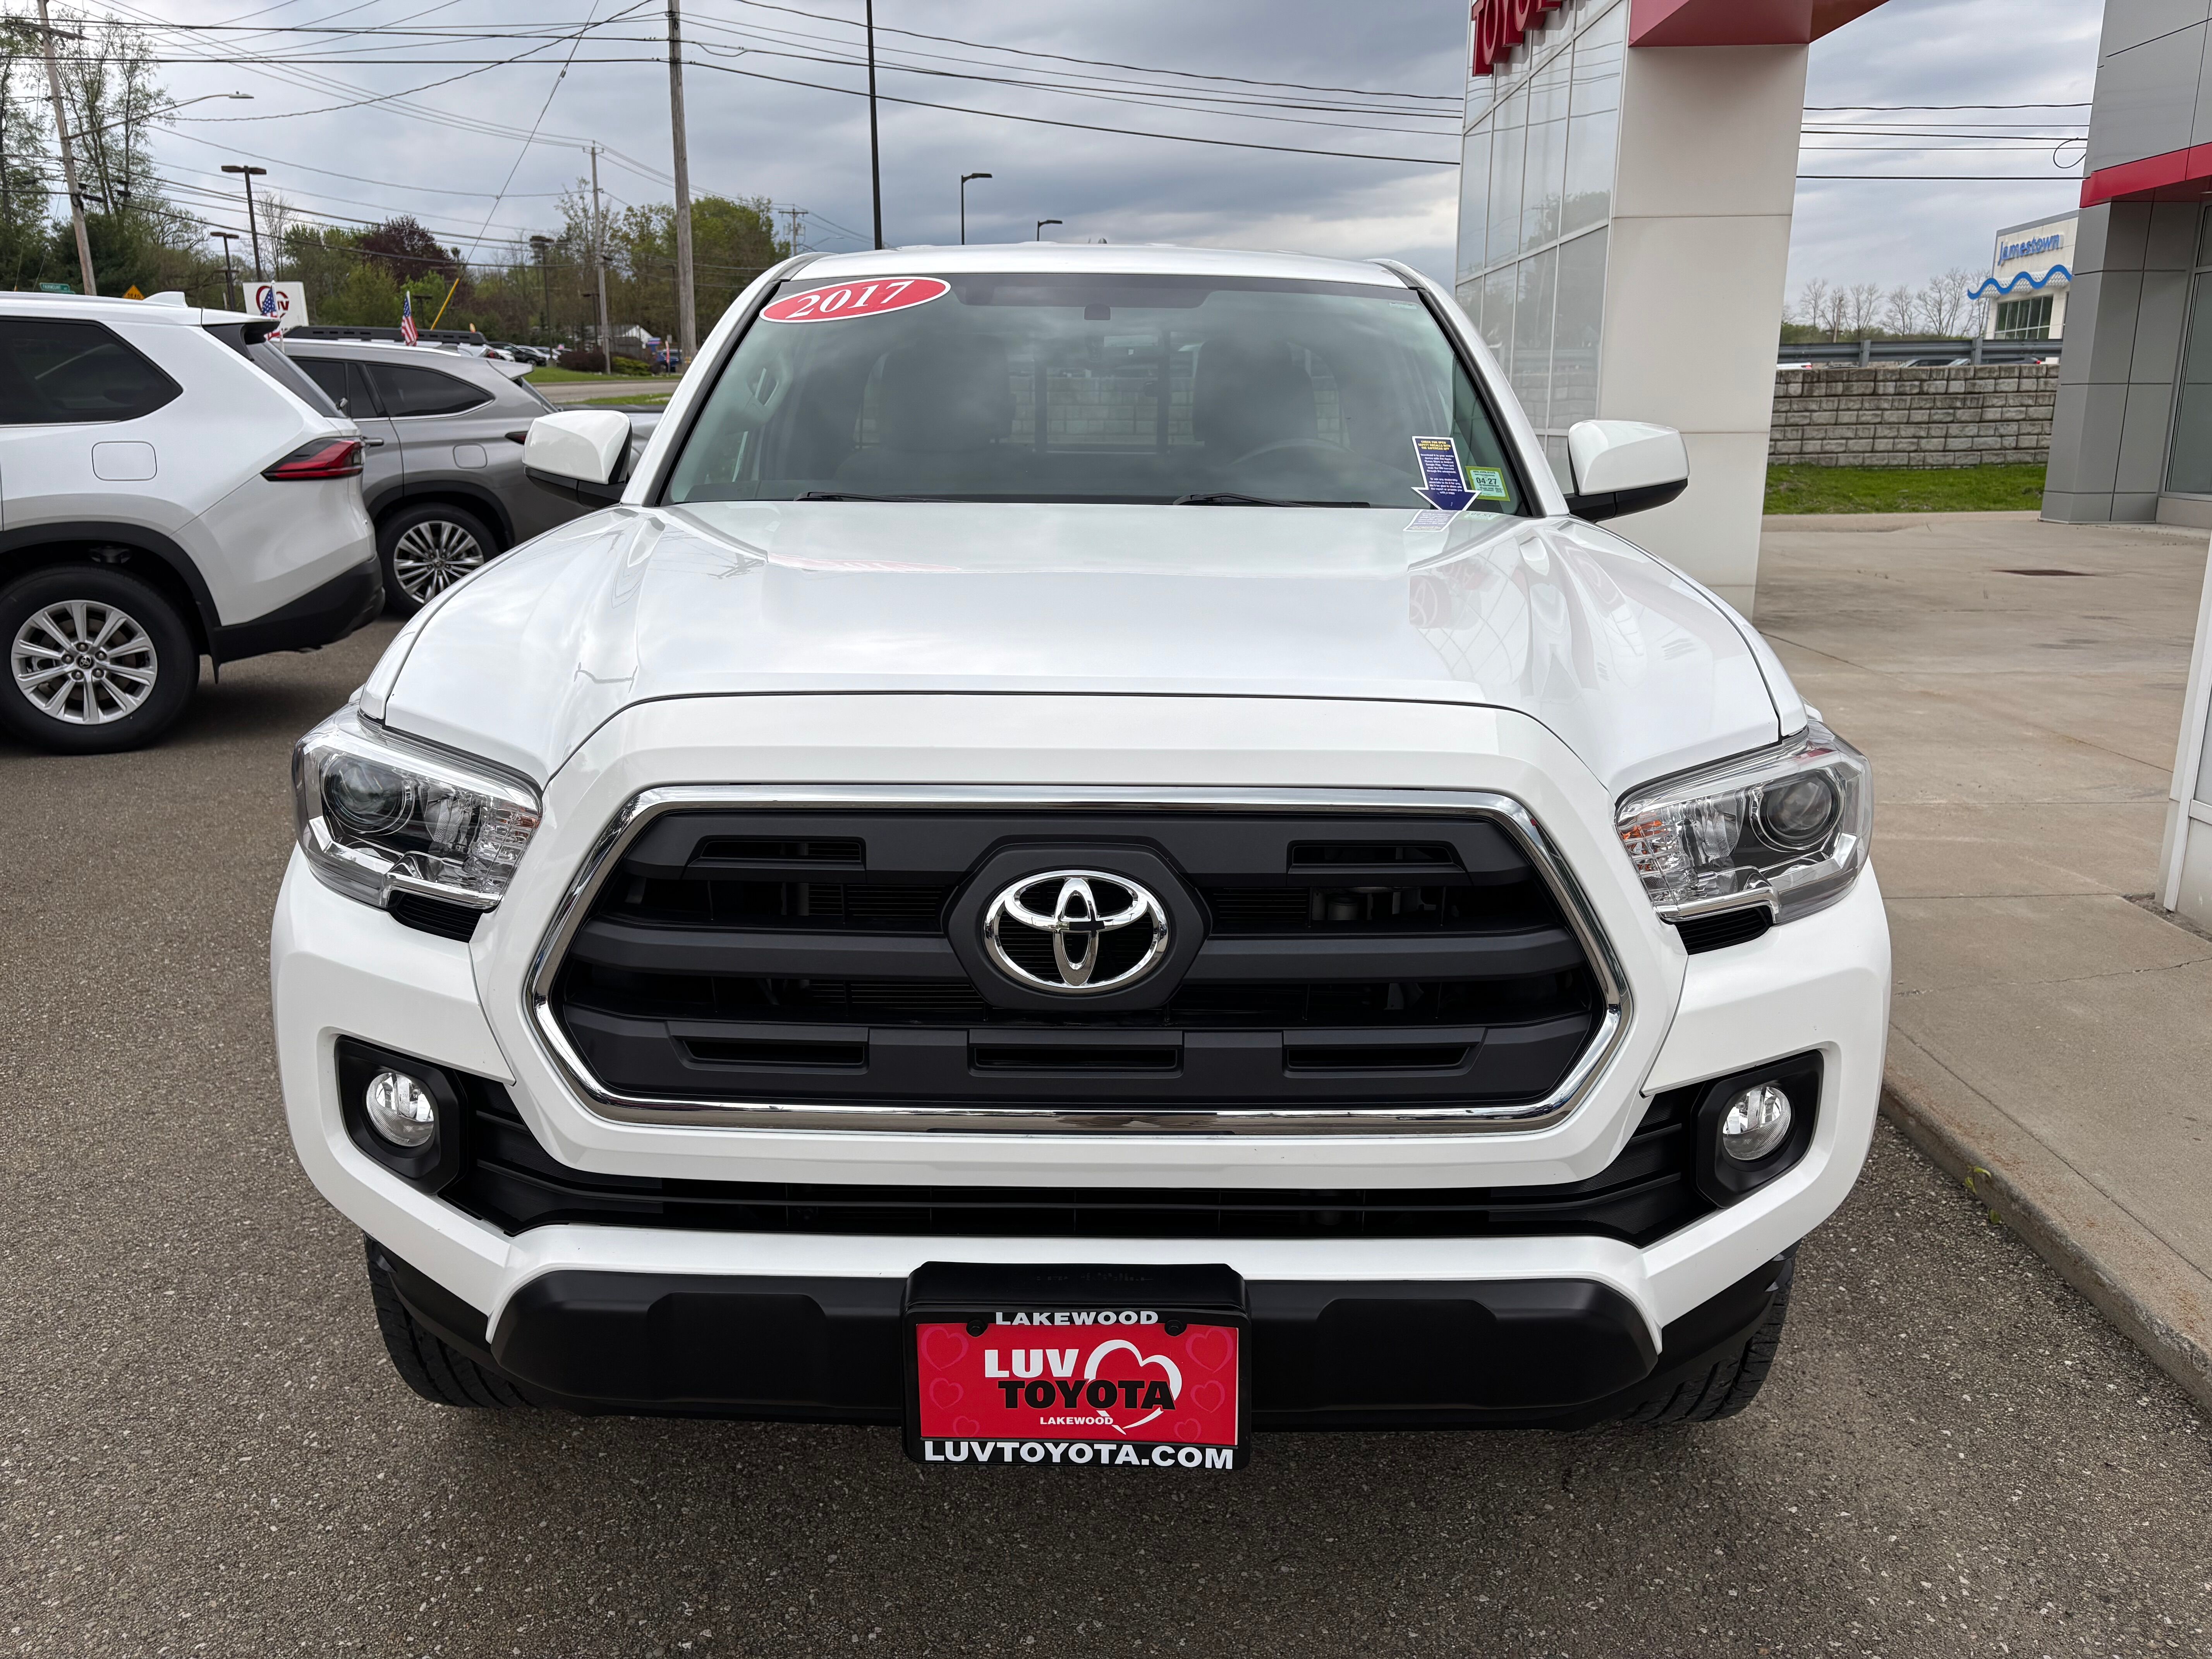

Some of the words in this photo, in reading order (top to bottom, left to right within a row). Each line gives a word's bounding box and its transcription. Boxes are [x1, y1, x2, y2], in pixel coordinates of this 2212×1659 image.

[1472, 0, 1562, 77] TOY
[1997, 234, 2059, 266] Jamestown
[785, 280, 915, 319] 2017
[996, 1311, 1158, 1325] LAKEWOOD
[985, 1349, 1079, 1378] LUV
[998, 1379, 1176, 1410] TOYOTA
[1040, 1417, 1113, 1425] LAKEWOOD
[925, 1441, 1233, 1469] LUVTOYOTA.COM
